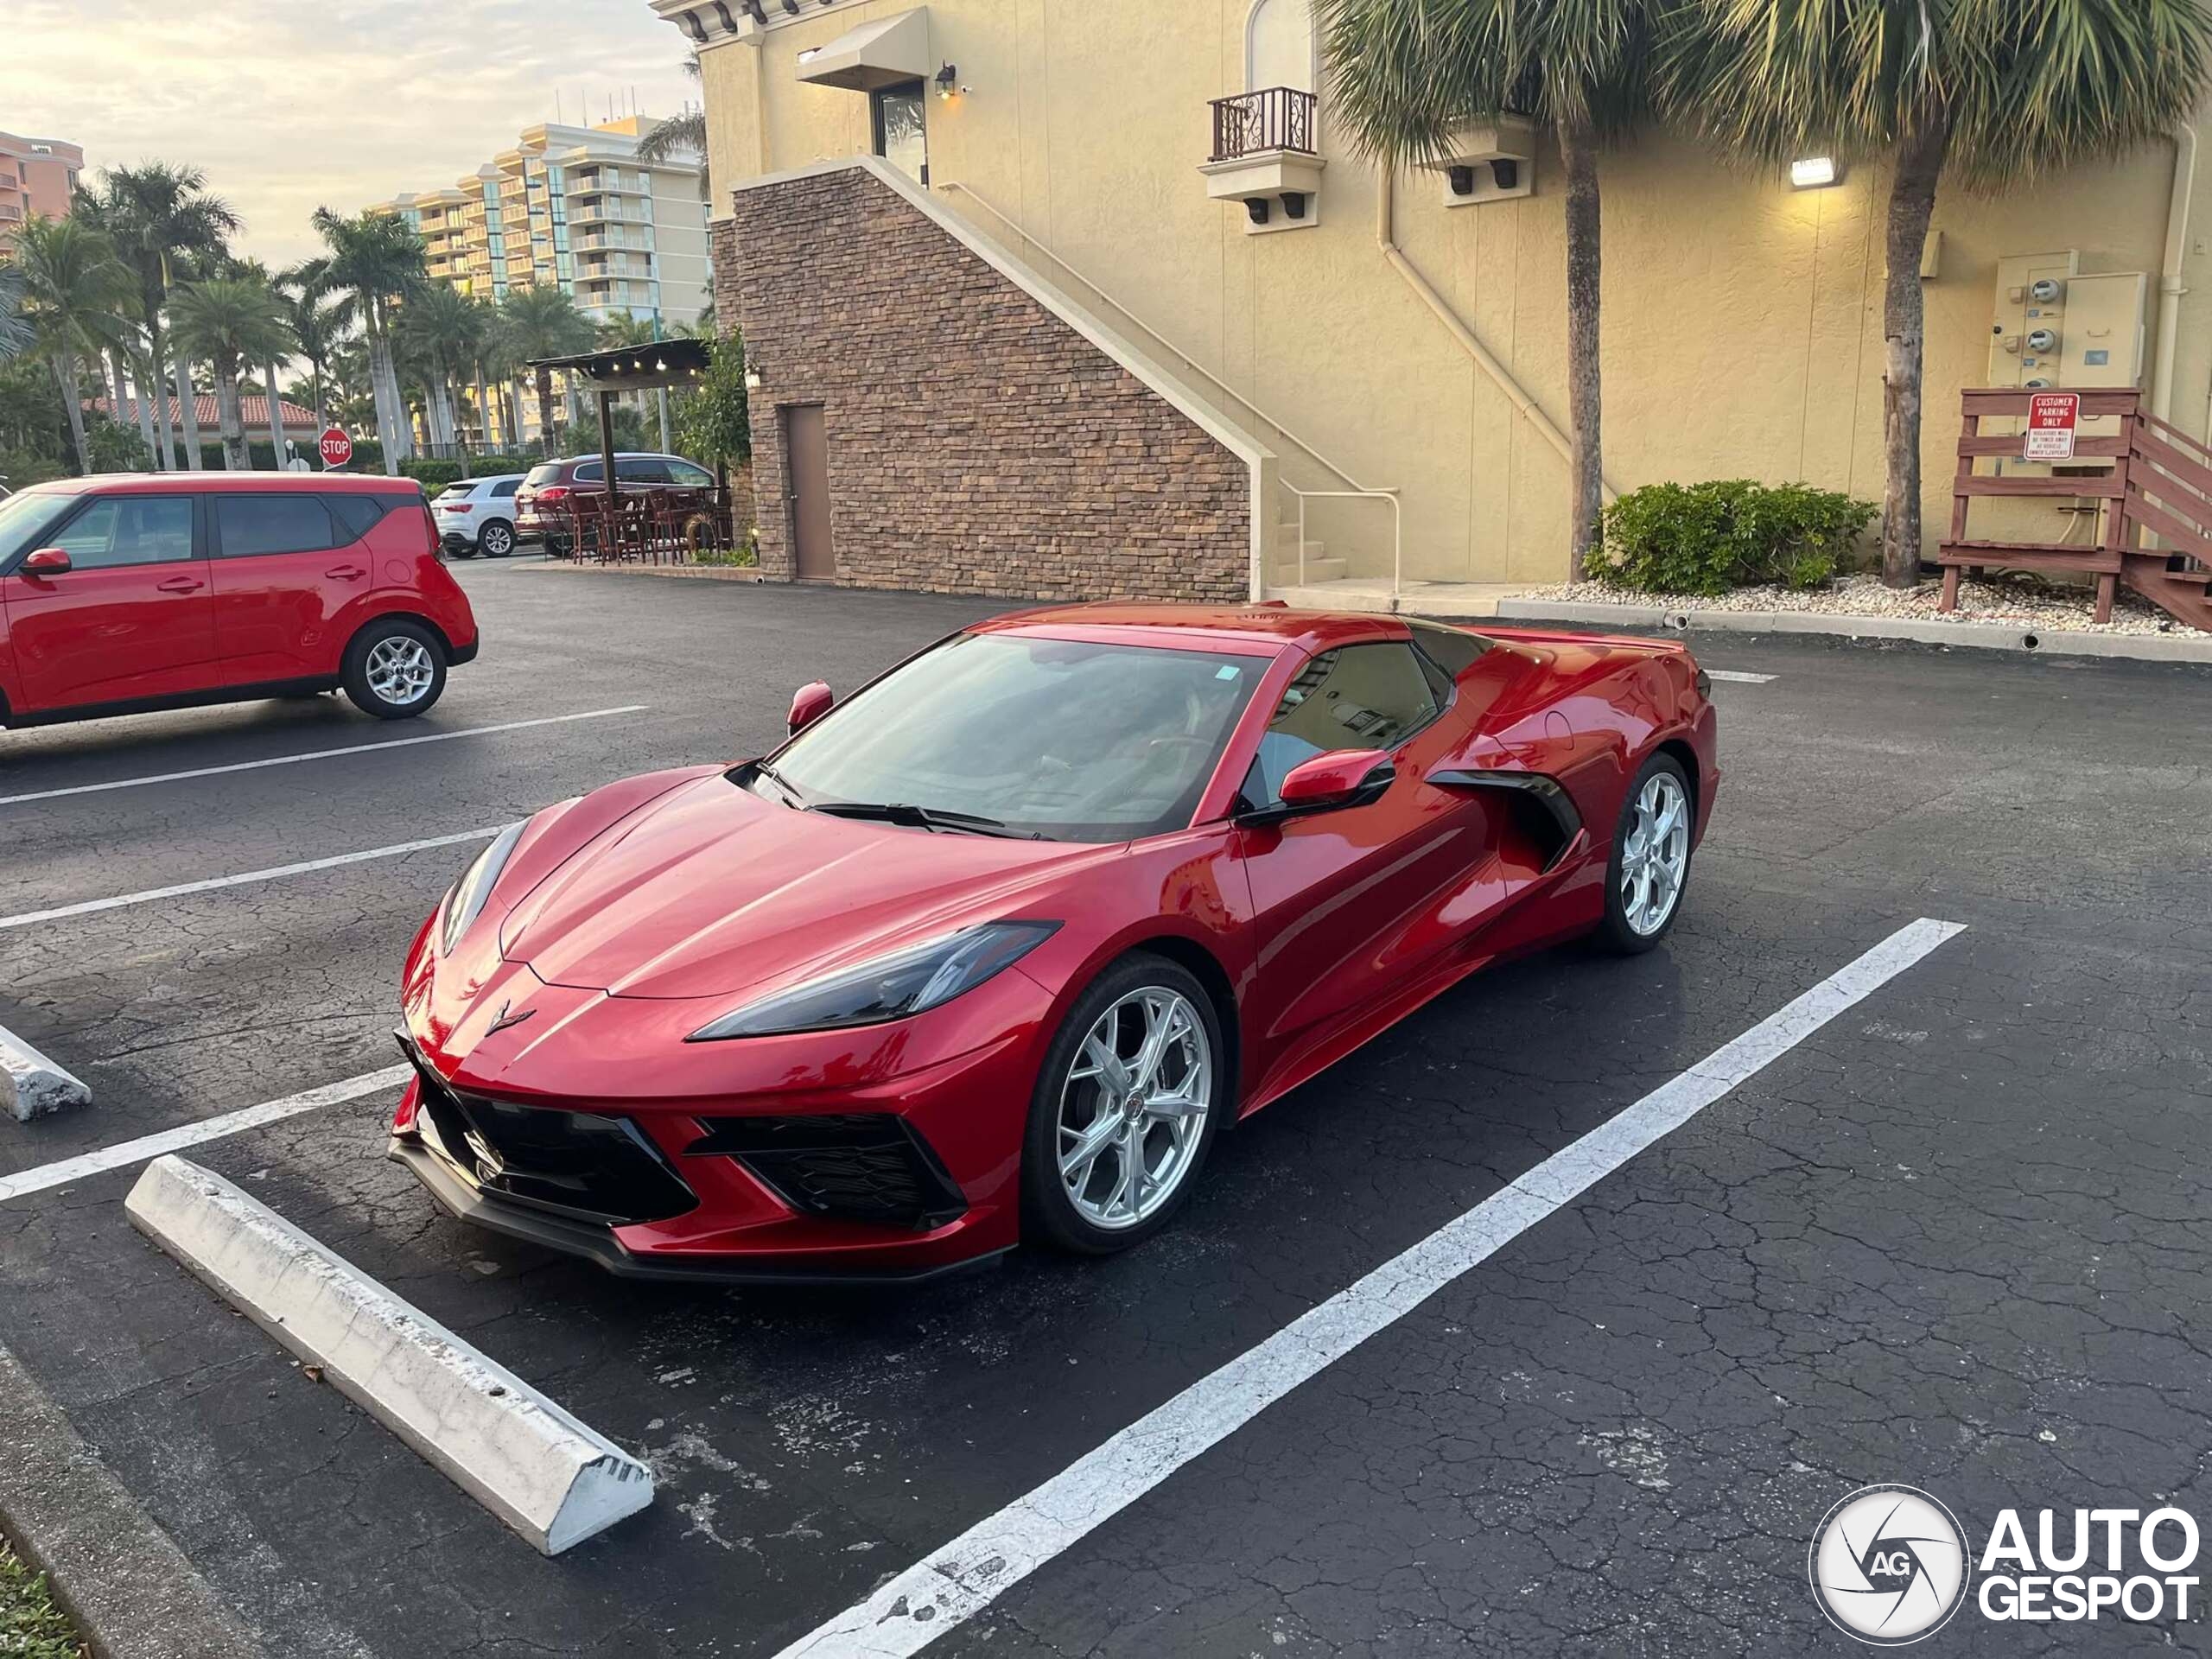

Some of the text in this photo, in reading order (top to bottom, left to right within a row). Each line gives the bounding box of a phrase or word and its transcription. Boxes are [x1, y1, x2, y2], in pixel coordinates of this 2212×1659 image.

[2036, 397, 2074, 407] CUSTOMER
[2037, 407, 2069, 416] PARKING
[2042, 417, 2062, 427] ONLY
[322, 440, 349, 454] STOP
